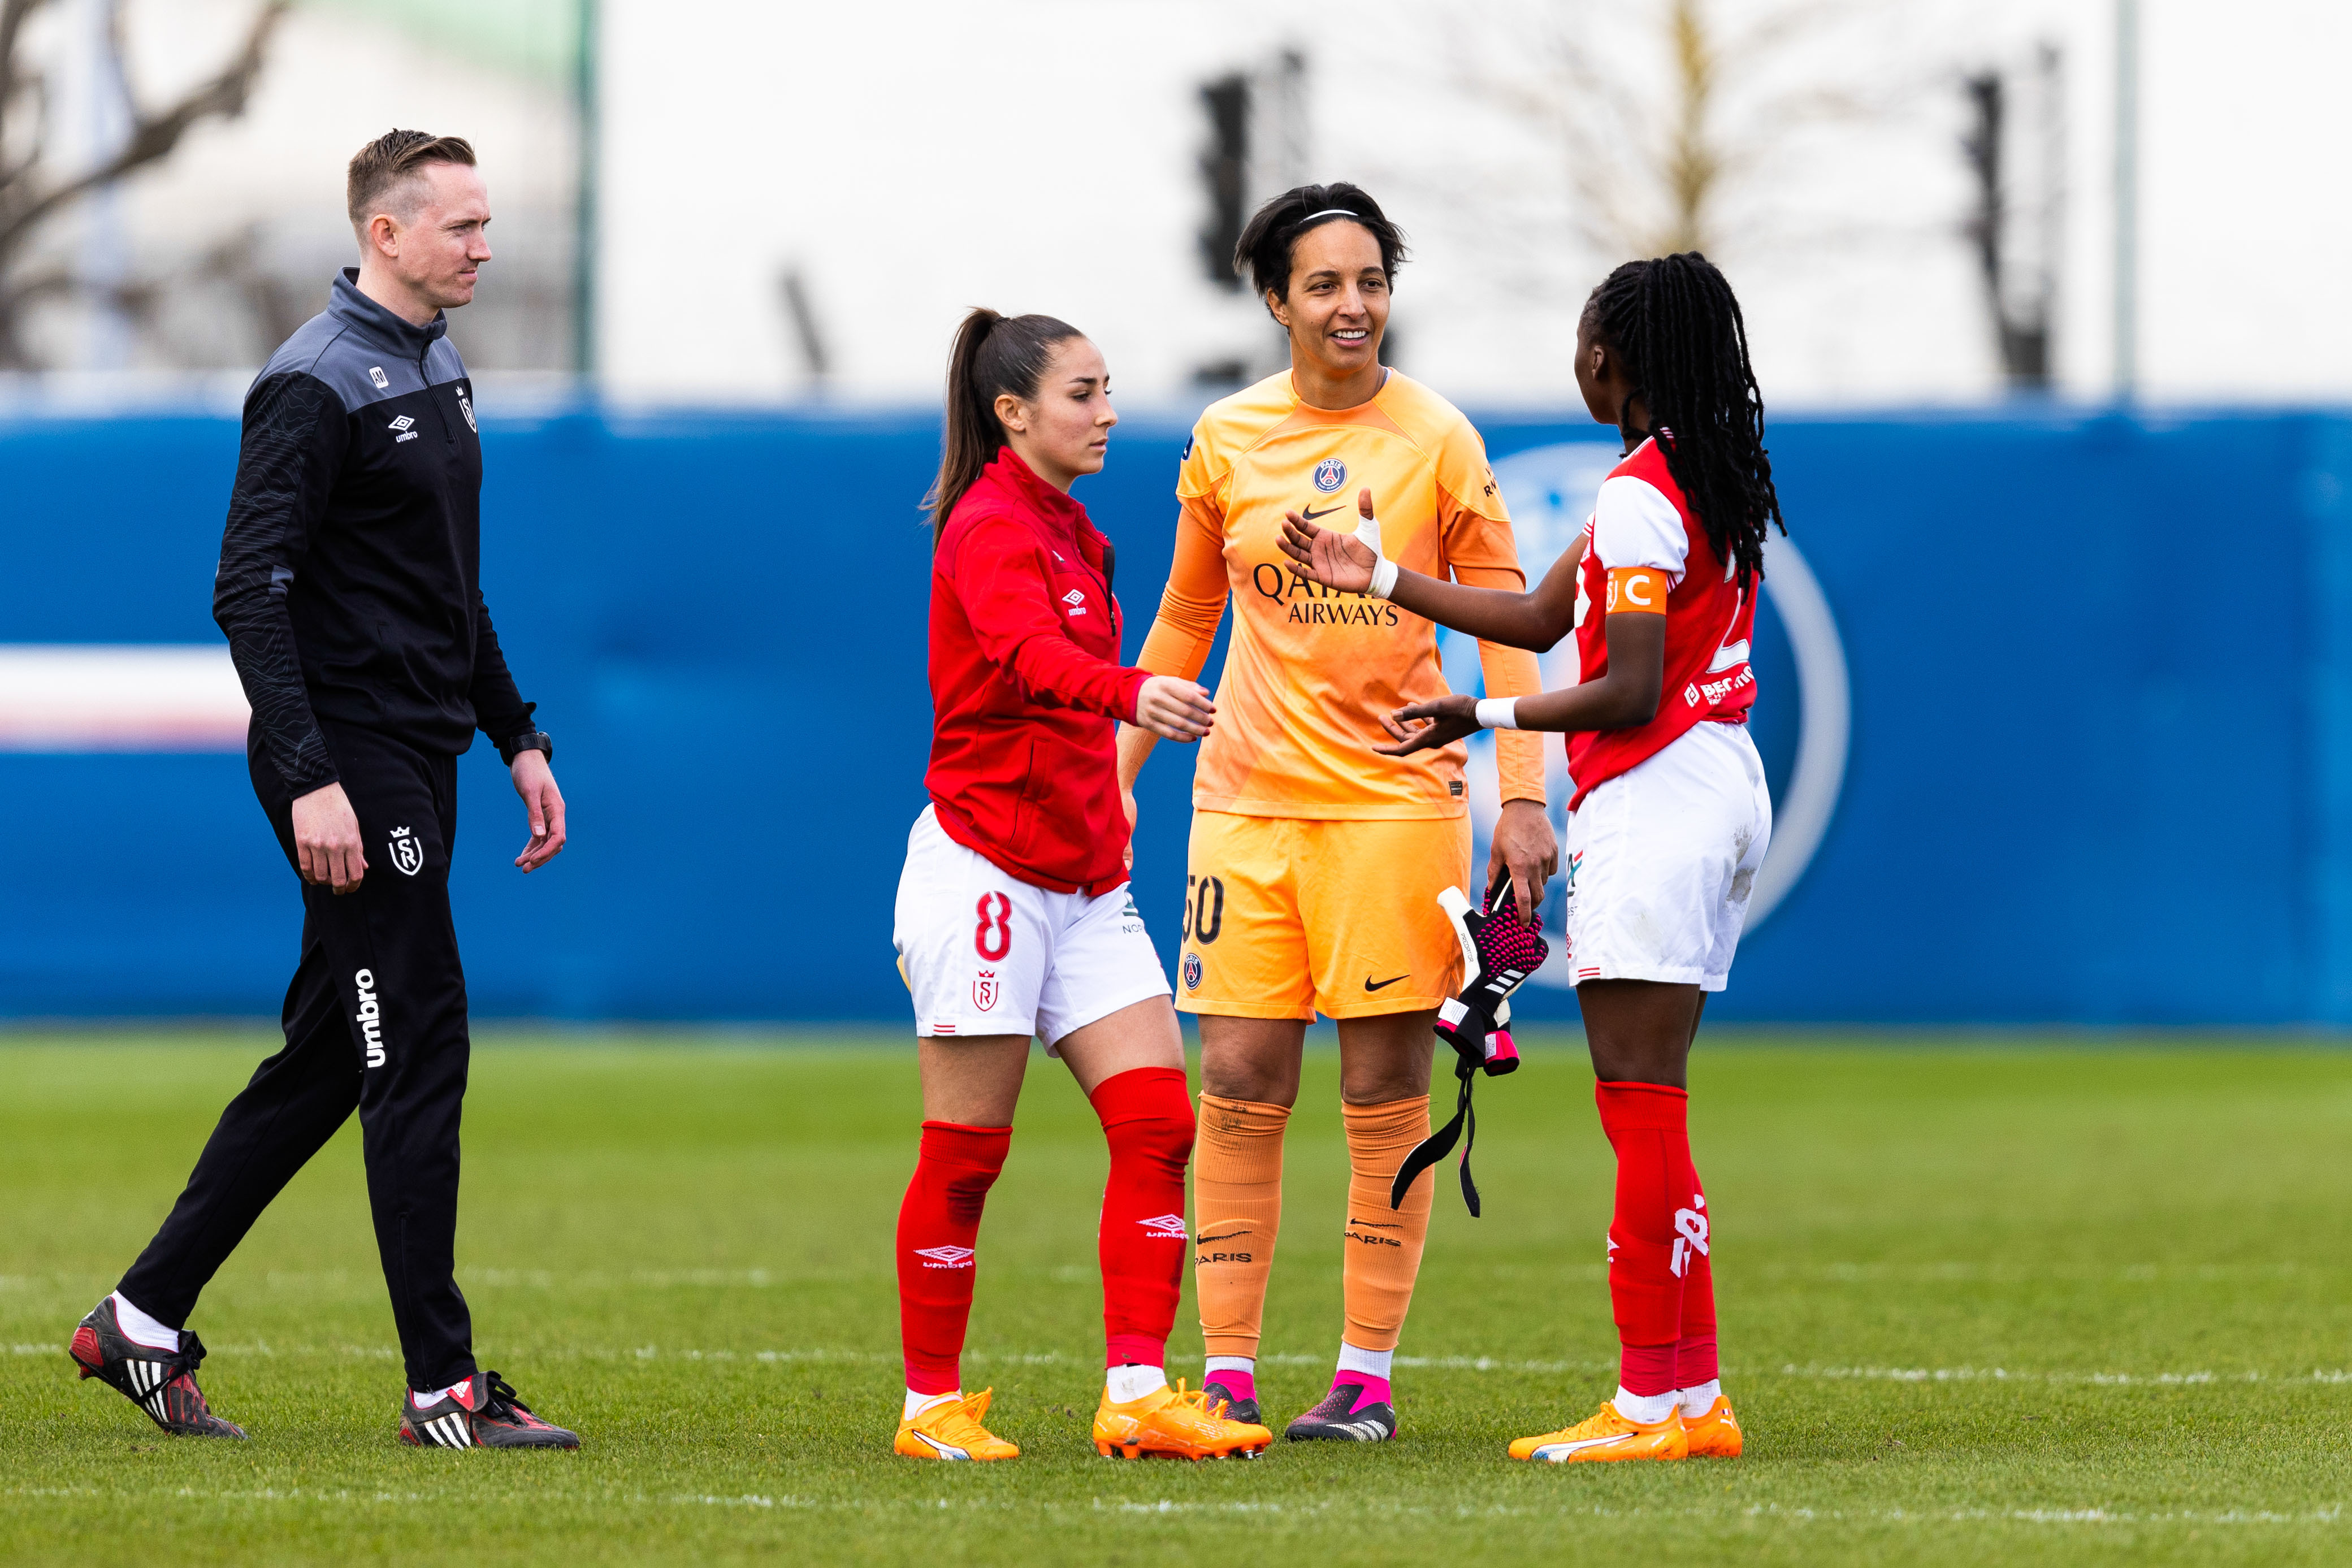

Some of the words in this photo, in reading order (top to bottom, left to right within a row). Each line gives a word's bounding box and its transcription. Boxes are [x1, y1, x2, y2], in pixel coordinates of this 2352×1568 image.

[396, 431, 418, 443] umbro
[1320, 460, 1342, 470] PARIS
[1625, 575, 1651, 606] C
[1068, 606, 1086, 616] umbro
[1288, 603, 1398, 626] AIRWAYS
[974, 891, 1012, 963] 8
[356, 969, 385, 1068] umbro
[1194, 1253, 1252, 1269] PARIS
